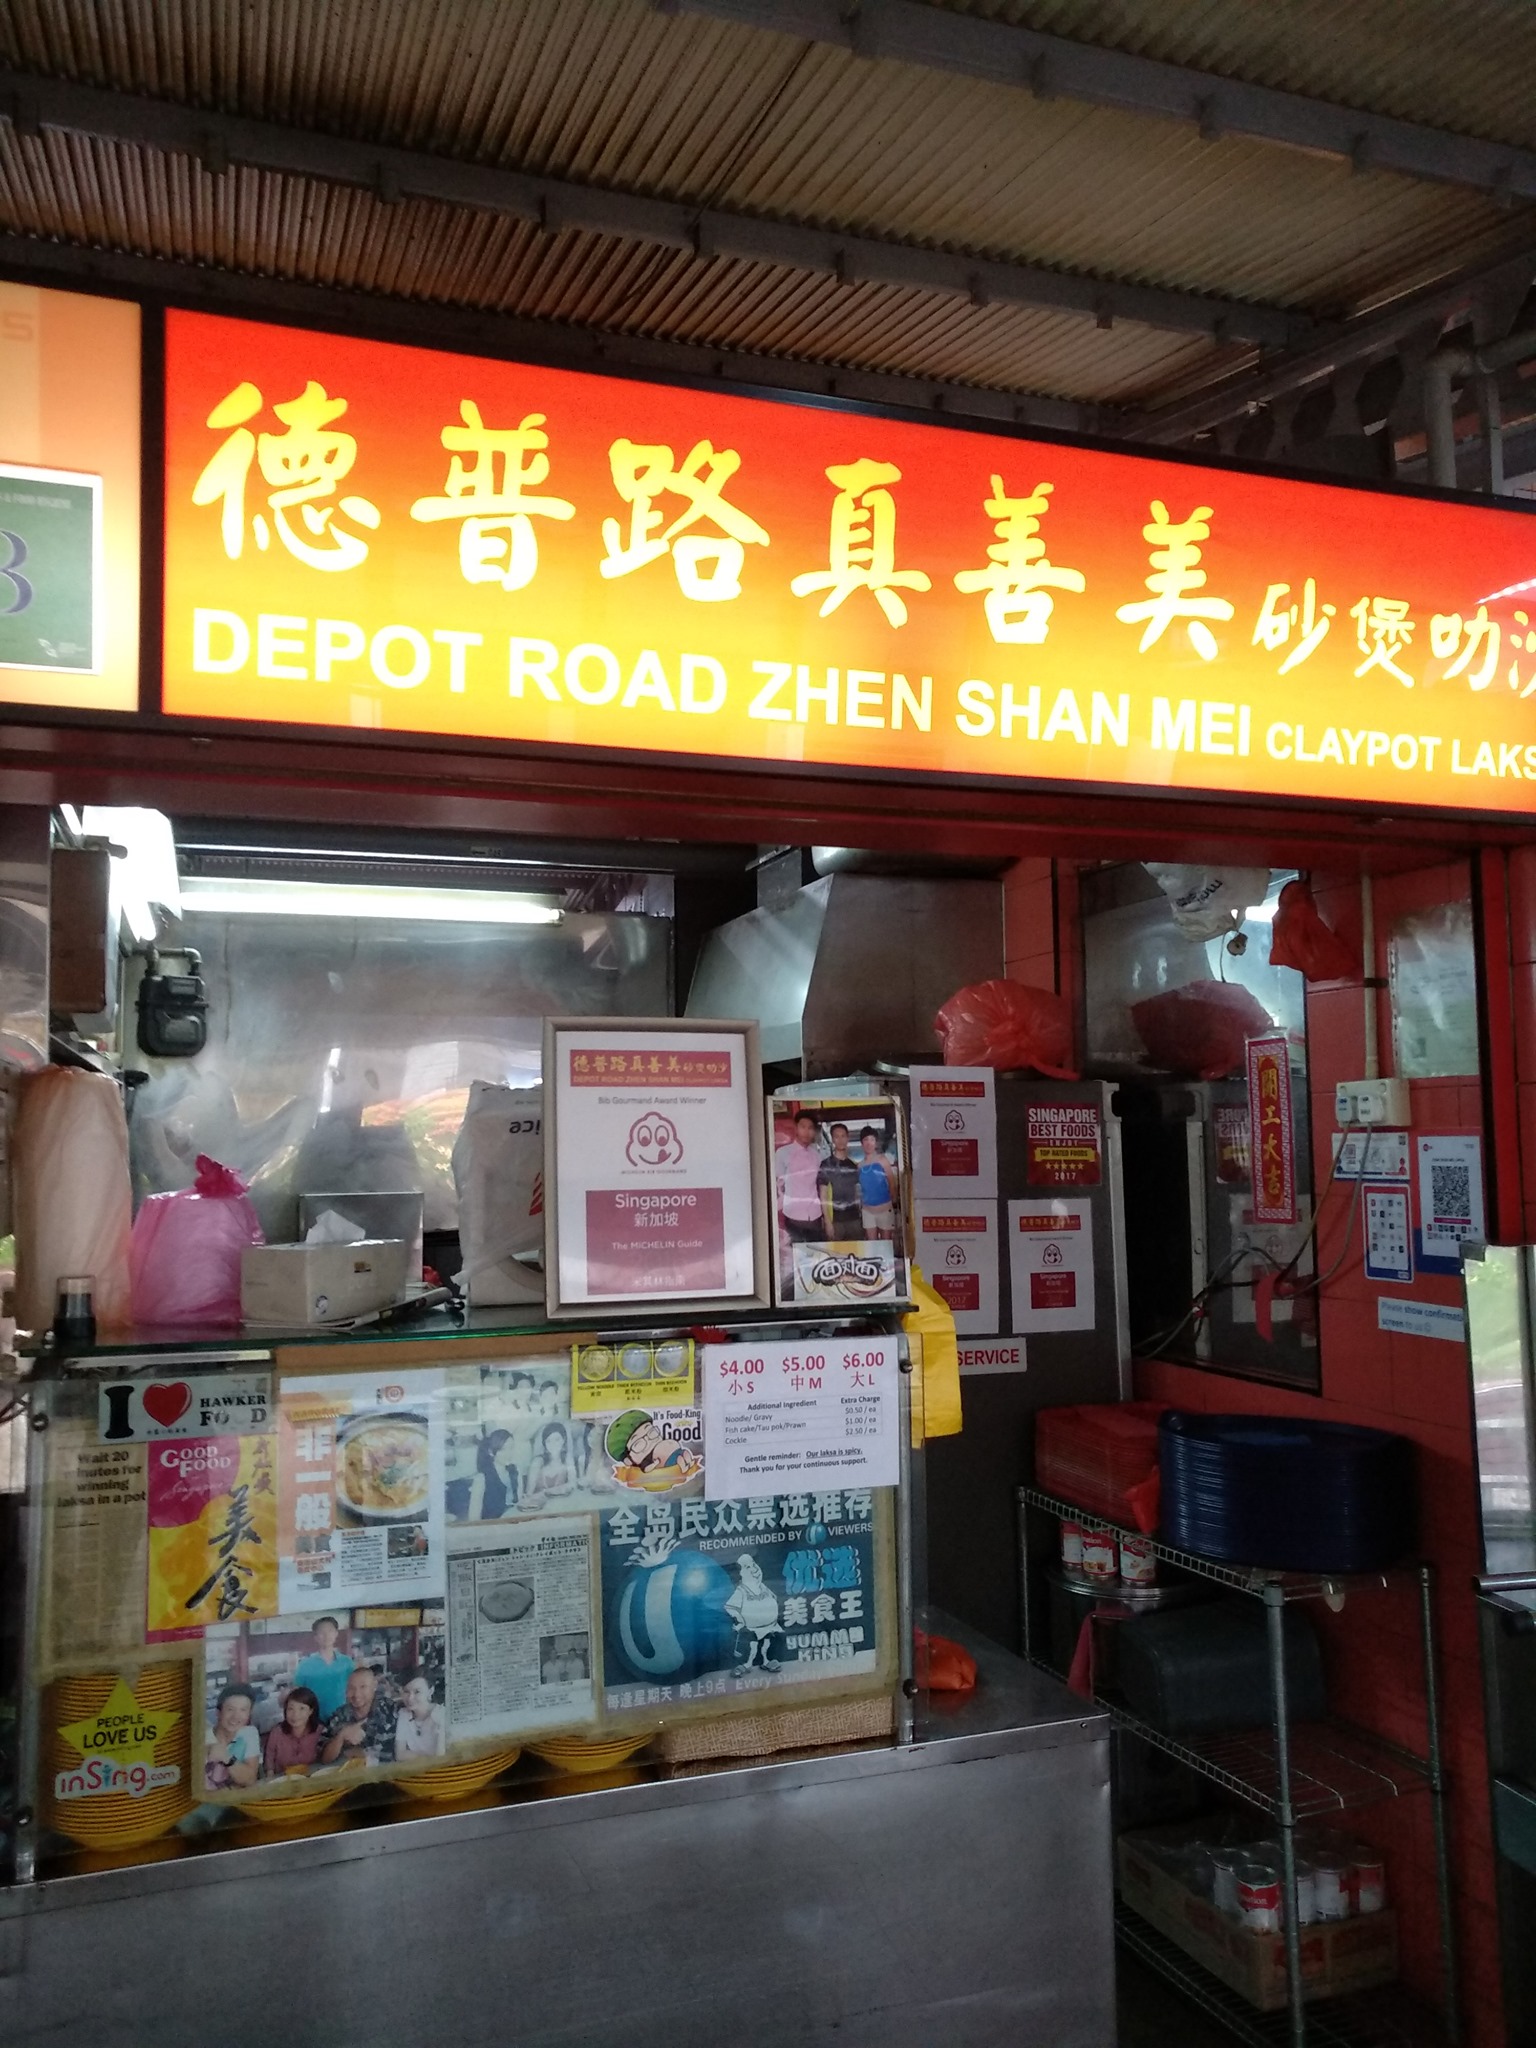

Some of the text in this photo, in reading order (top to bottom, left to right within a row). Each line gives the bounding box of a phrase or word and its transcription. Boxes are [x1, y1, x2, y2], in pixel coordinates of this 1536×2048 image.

[193, 607, 483, 694] DEPOT
[509, 636, 728, 715] ROAD
[748, 661, 933, 732] ZHEN
[955, 679, 1130, 747] SHAN
[1151, 696, 1252, 757] MEI
[1266, 721, 1442, 772] CLAYPOT
[654, 1097, 677, 1105] Award
[680, 1096, 707, 1105] Winner
[1028, 1107, 1097, 1122] SINGAPORE
[1030, 1124, 1096, 1137] BEST FOODS
[1055, 1171, 1077, 1180] 2017
[615, 1193, 697, 1210] Singapore
[634, 1211, 679, 1228] 新加坡
[612, 1239, 703, 1251] The MICHELIN Guide
[1404, 1306, 1422, 1315] show
[719, 1358, 765, 1378] $4.00
[782, 1355, 825, 1374] $5.00
[842, 1351, 885, 1371] $6.00
[728, 1379, 755, 1396] 小 S
[791, 1374, 822, 1392] 中 M
[850, 1371, 876, 1389] 大 L
[200, 1395, 266, 1408] HAWKER
[747, 1399, 817, 1411] Additional Ingredient
[840, 1395, 880, 1405] Extra Charge
[103, 1385, 135, 1439] I
[200, 1408, 267, 1427] FOD
[666, 1409, 701, 1420] Food-King
[753, 1413, 773, 1423] Gravy
[845, 1406, 862, 1415] $0.50
[725, 1421, 807, 1434] Fish cake/Tau pok/Prawn
[845, 1416, 863, 1425] $1.00
[662, 1421, 702, 1441] Good
[845, 1427, 863, 1436] $2.50
[112, 1451, 129, 1461] 20
[160, 1446, 219, 1468] GOOD
[745, 1447, 863, 1463] Gentle reminder: Our laksa is spicy.
[122, 1465, 142, 1475] for
[179, 1456, 231, 1478] FOOD
[739, 1457, 868, 1474] Thank you for your continuous support.
[77, 1480, 129, 1491] winning
[98, 1494, 110, 1504] in
[113, 1495, 121, 1503] a
[124, 1491, 146, 1504] pot
[699, 1521, 873, 1551] RECOMMENDED BY VIEWERS
[783, 1589, 864, 1626] 美食王
[679, 1679, 727, 1700] 晚上9点
[735, 1674, 771, 1691] Every
[96, 1713, 145, 1728] PEOPLE
[83, 1725, 157, 1748] LOVE US
